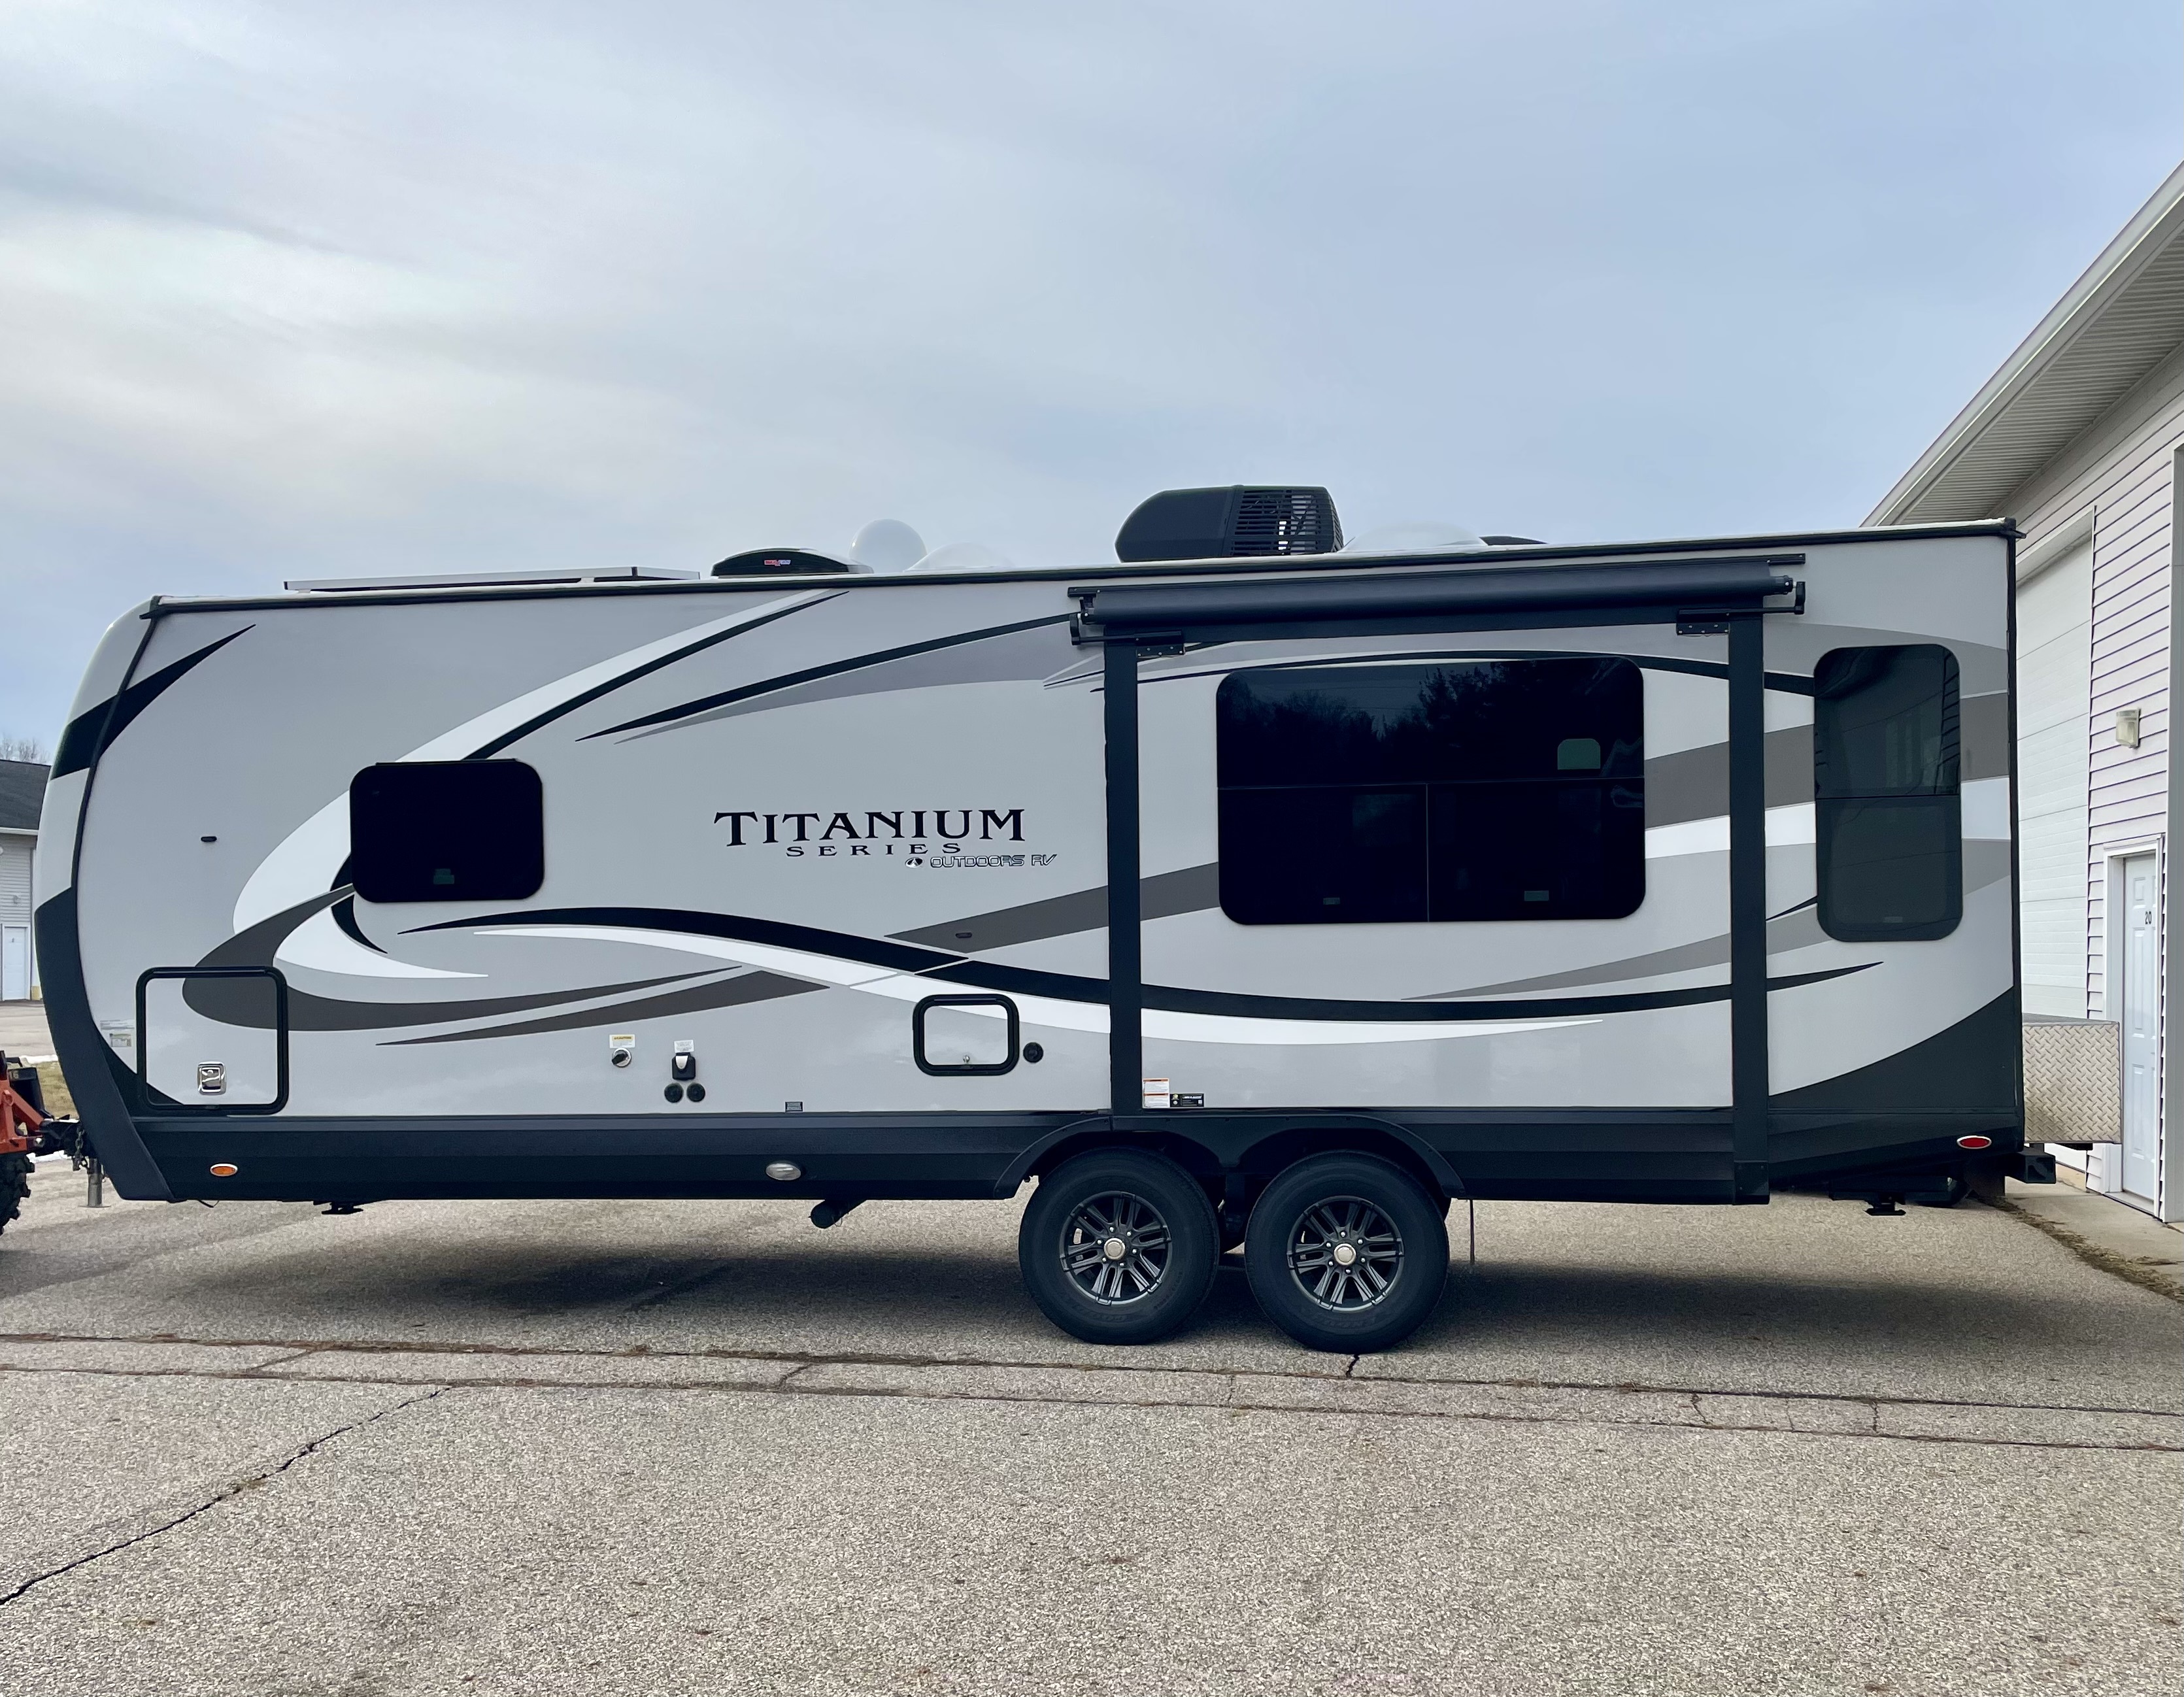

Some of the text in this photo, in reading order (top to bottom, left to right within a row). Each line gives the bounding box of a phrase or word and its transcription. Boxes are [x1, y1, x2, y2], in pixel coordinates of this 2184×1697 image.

[713, 809, 1026, 847] TITANIUM
[785, 843, 962, 857] SERIES
[930, 854, 1058, 868] OUTDOORS RV
[2145, 911, 2153, 925] 20
